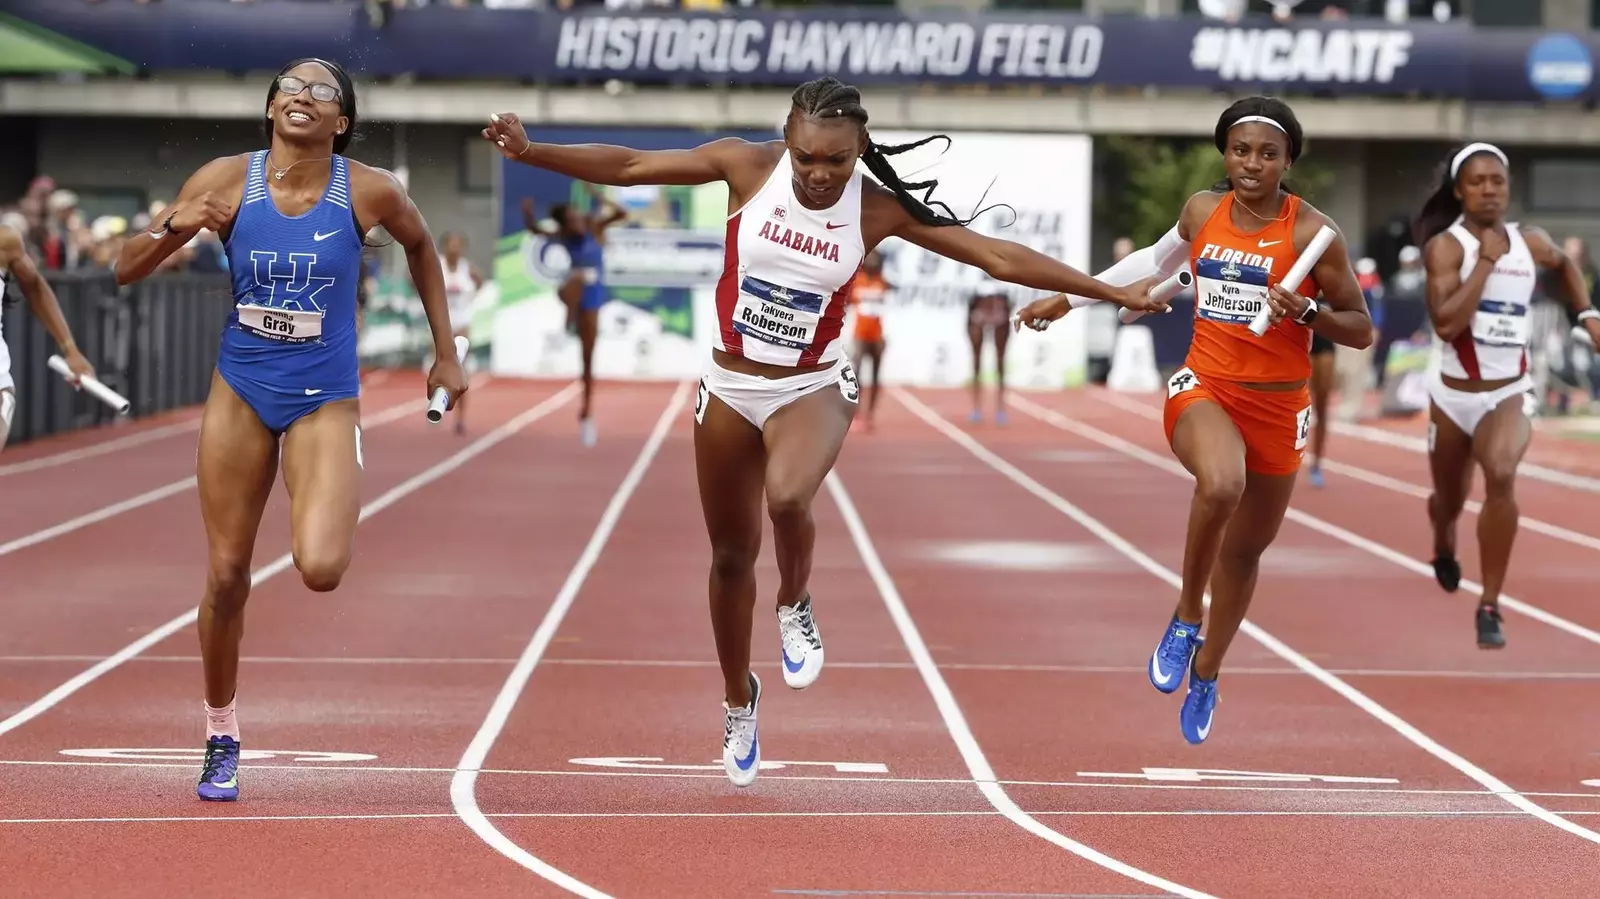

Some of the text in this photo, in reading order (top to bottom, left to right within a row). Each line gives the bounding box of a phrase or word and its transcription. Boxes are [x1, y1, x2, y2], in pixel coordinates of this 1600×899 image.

[556, 18, 1104, 80] HISTORIC HAYWARD FIELD
[1190, 28, 1413, 83] #NCAATF
[758, 221, 840, 262] ALABAMA
[1199, 243, 1274, 273] FLORIDA
[1221, 284, 1240, 295] Kyra
[263, 315, 296, 335] Gray
[741, 307, 807, 339] Roberson
[760, 302, 795, 322] Takyera
